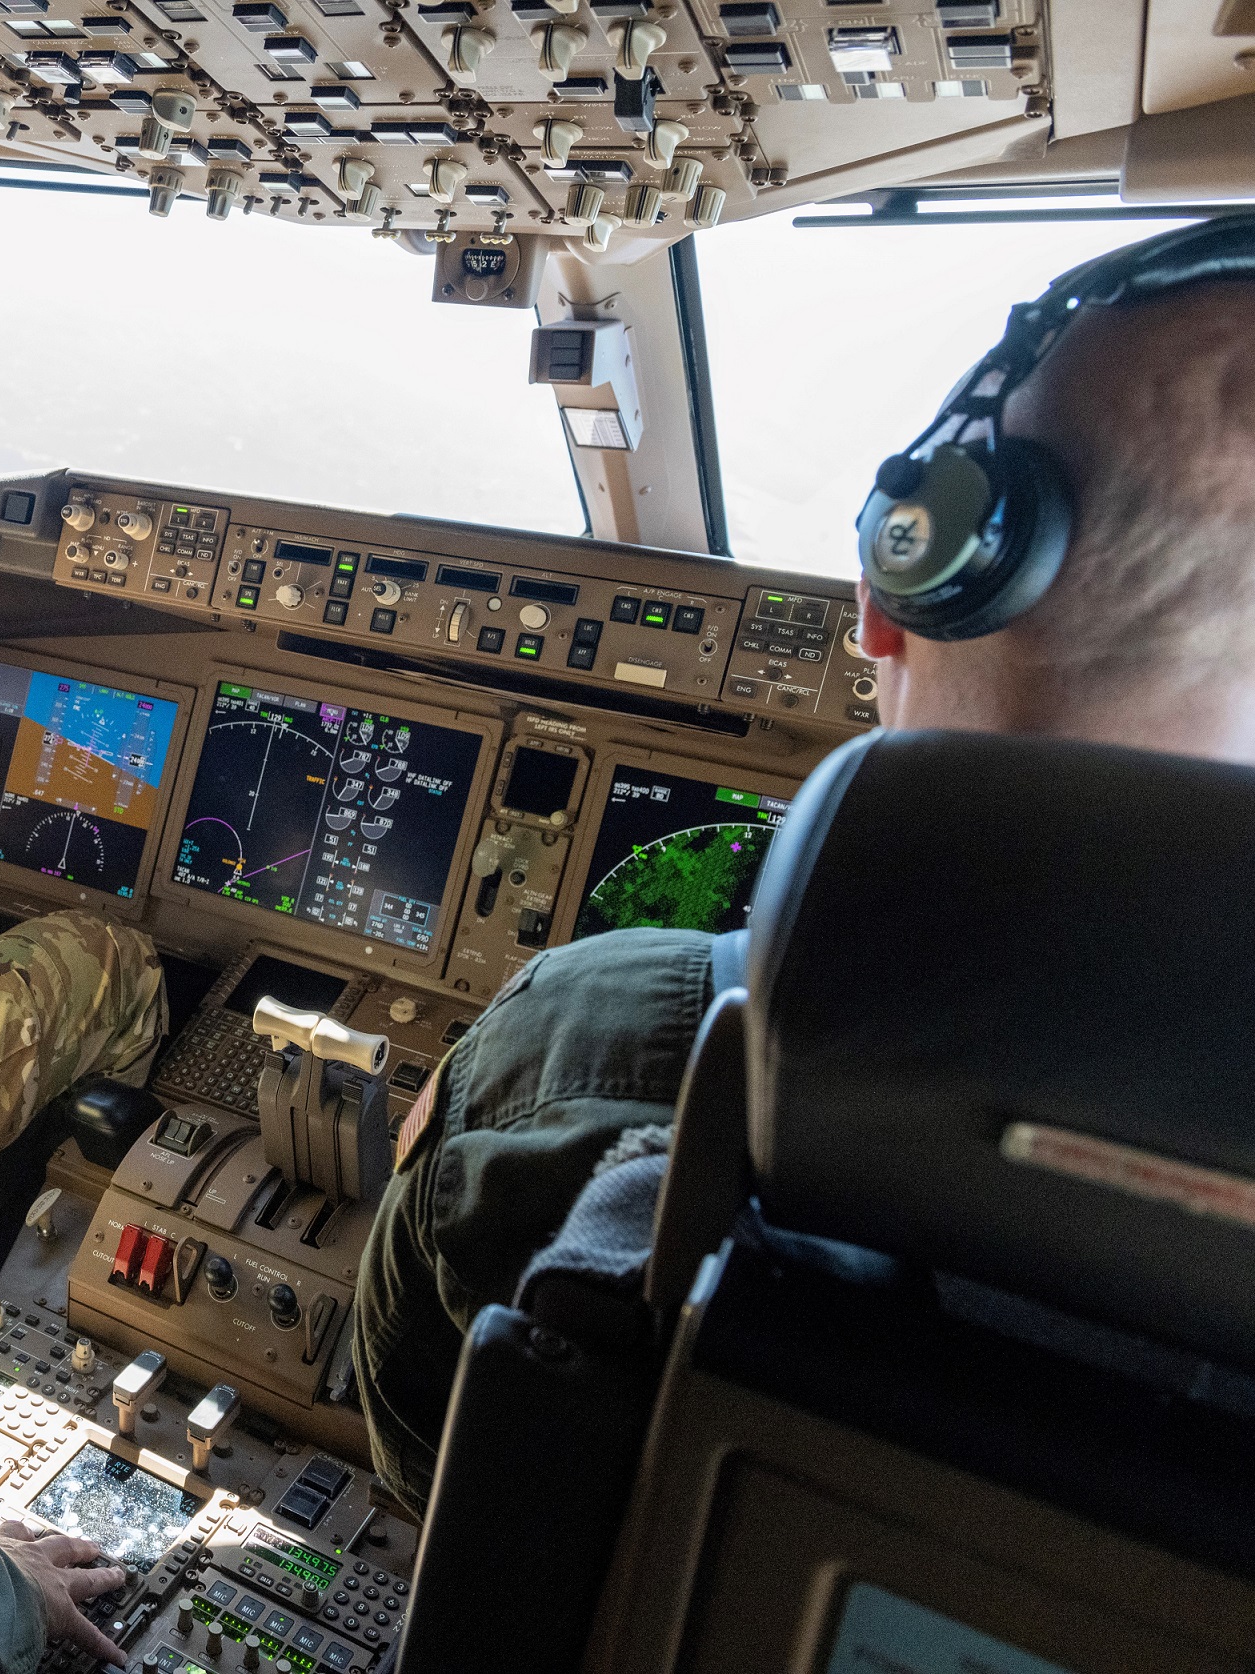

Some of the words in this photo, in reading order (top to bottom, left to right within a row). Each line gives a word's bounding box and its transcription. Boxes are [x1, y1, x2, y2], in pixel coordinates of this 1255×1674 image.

[177, 548, 193, 556] COMM
[155, 582, 166, 590] ENG
[787, 596, 803, 604] MFD
[621, 602, 632, 610] CMD
[750, 623, 763, 631] SYS
[777, 627, 794, 637] TSAS
[806, 633, 823, 641] INFO
[744, 640, 760, 649] CHKL
[769, 644, 792, 655] COMM
[804, 651, 816, 659] ND
[628, 656, 663, 668] DISENGAGE
[768, 659, 787, 668] EICAS
[844, 670, 861, 679] MAP
[736, 685, 752, 694] ENG
[776, 684, 810, 696] CANC/RCL
[271, 713, 282, 721] 129
[854, 710, 870, 719] WXR
[541, 719, 568, 729] HEADING
[569, 724, 587, 733] FROM
[558, 728, 576, 736] ONLY
[413, 778, 438, 789] DATALINK
[439, 784, 448, 792] OFF
[418, 774, 442, 784] DATALINK
[443, 779, 453, 787] OFF
[732, 793, 744, 801] MAP
[767, 800, 792, 811] TACAN/
[150, 1152, 167, 1162] NOSE
[152, 1224, 168, 1235] STAB
[92, 1249, 115, 1263] CUTOUT
[245, 1258, 259, 1269] FUEL
[259, 1264, 289, 1281] CONTROL
[256, 1273, 271, 1283] RUN
[232, 1318, 256, 1332] CUTOFF
[64, 1384, 80, 1395] RIGHT
[114, 1461, 131, 1473] RTE
[260, 1575, 272, 1585] DATA
[213, 1590, 227, 1602] MIC
[242, 1605, 256, 1617] MIC
[270, 1620, 285, 1632] MIC
[299, 1636, 314, 1648] MIC
[158, 1658, 172, 1668] INT
[329, 1653, 344, 1665] MIC
